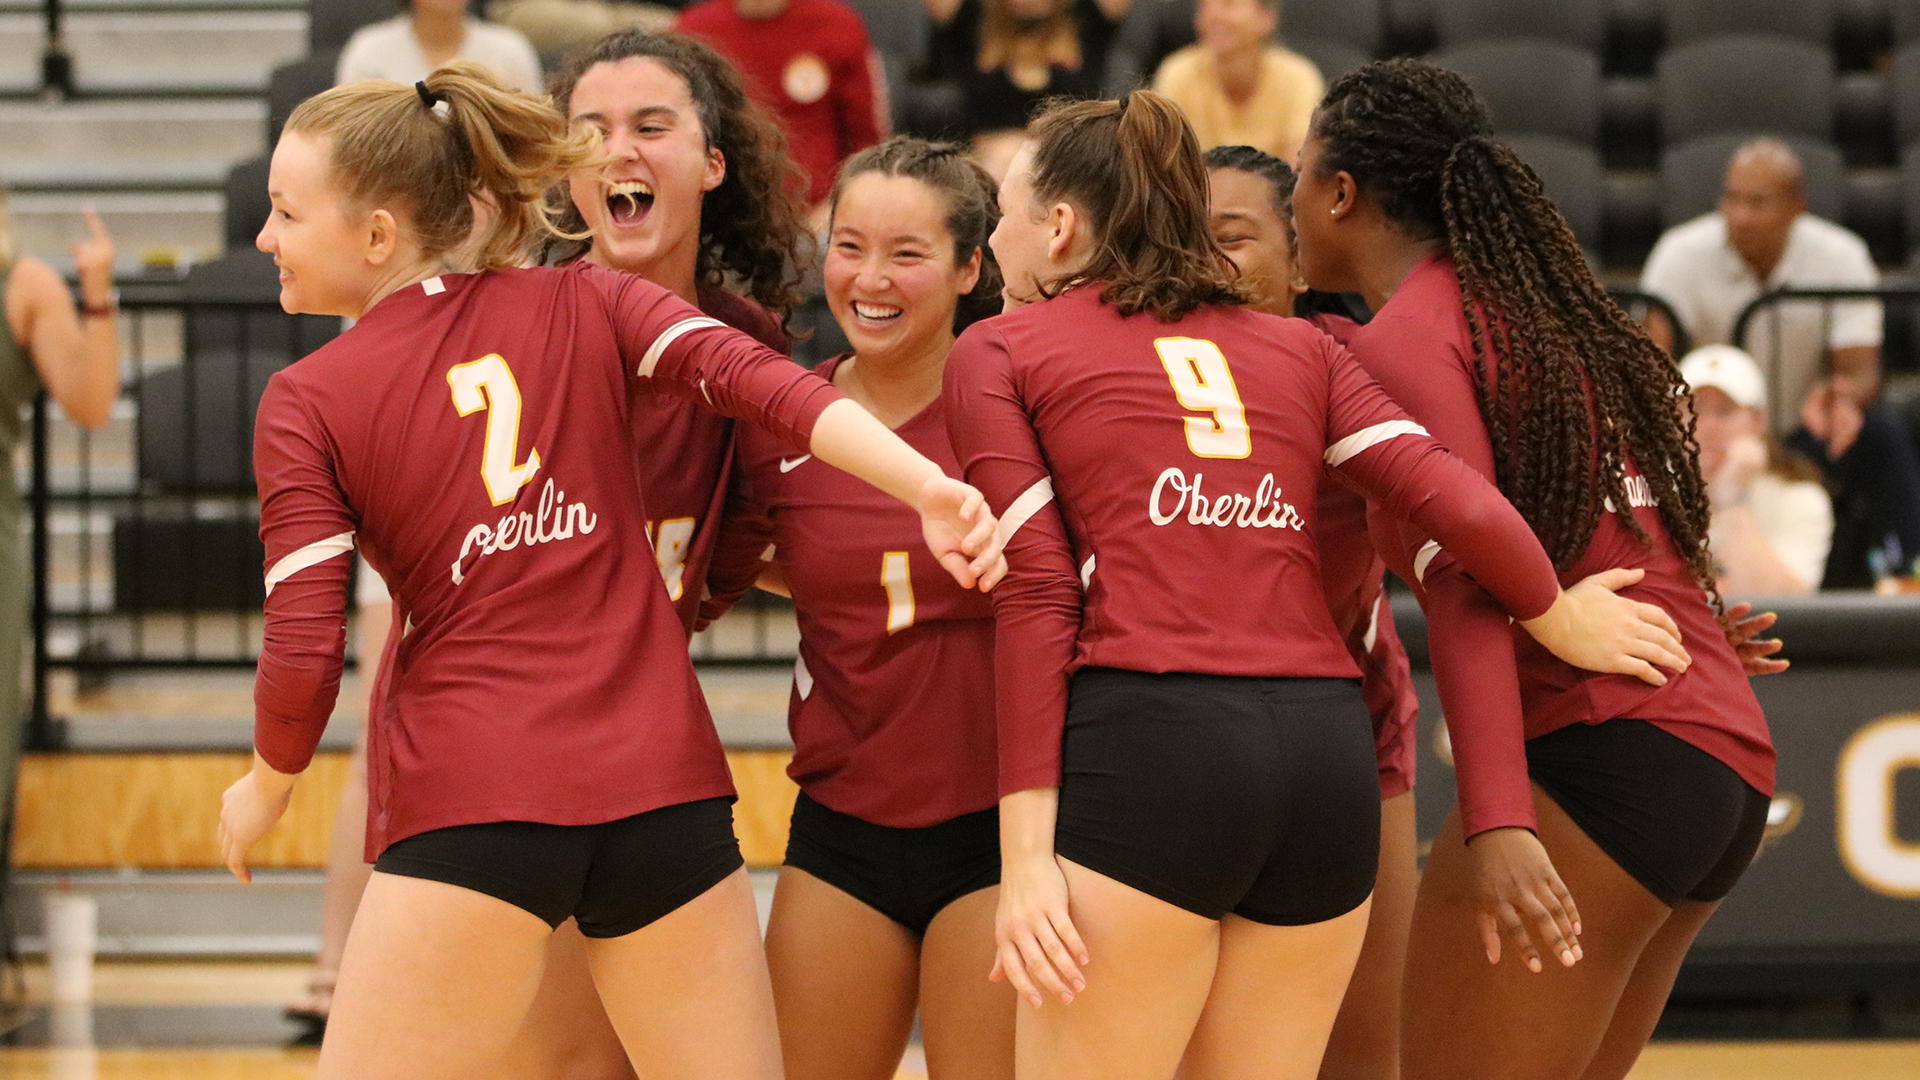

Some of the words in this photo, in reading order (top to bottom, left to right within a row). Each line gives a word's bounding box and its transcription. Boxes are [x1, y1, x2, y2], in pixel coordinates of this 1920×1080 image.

[446, 353, 541, 507] 2
[1153, 336, 1252, 460] 9
[1149, 467, 1305, 532] Oberlin
[881, 551, 916, 637] 1
